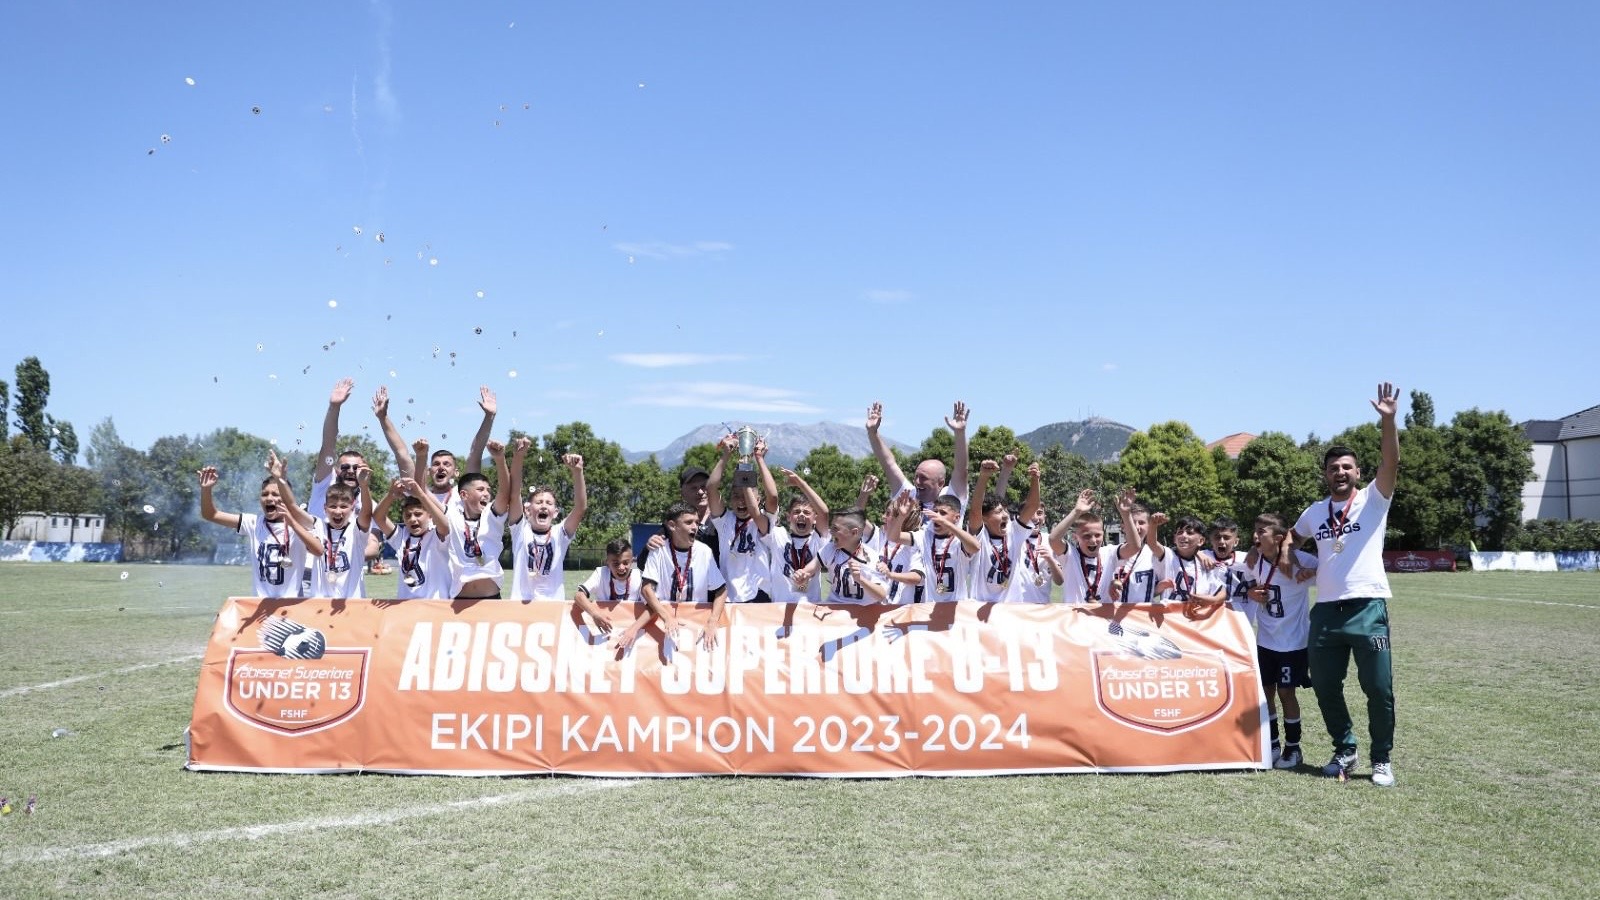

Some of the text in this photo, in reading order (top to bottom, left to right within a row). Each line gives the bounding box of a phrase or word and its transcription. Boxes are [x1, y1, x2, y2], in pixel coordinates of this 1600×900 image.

[398, 622, 646, 694] ABISSNET
[660, 624, 935, 695] SUPERIORE
[294, 666, 353, 681] Superiore
[1160, 665, 1218, 681] Superiore
[1281, 666, 1292, 684] 3
[239, 681, 352, 700] UNDER 13
[1108, 680, 1220, 700] UNDER 13
[280, 709, 308, 718] FSHF
[1153, 708, 1181, 718] FSHF
[430, 713, 1032, 753] EKIPI KAMPION 2023-2024
